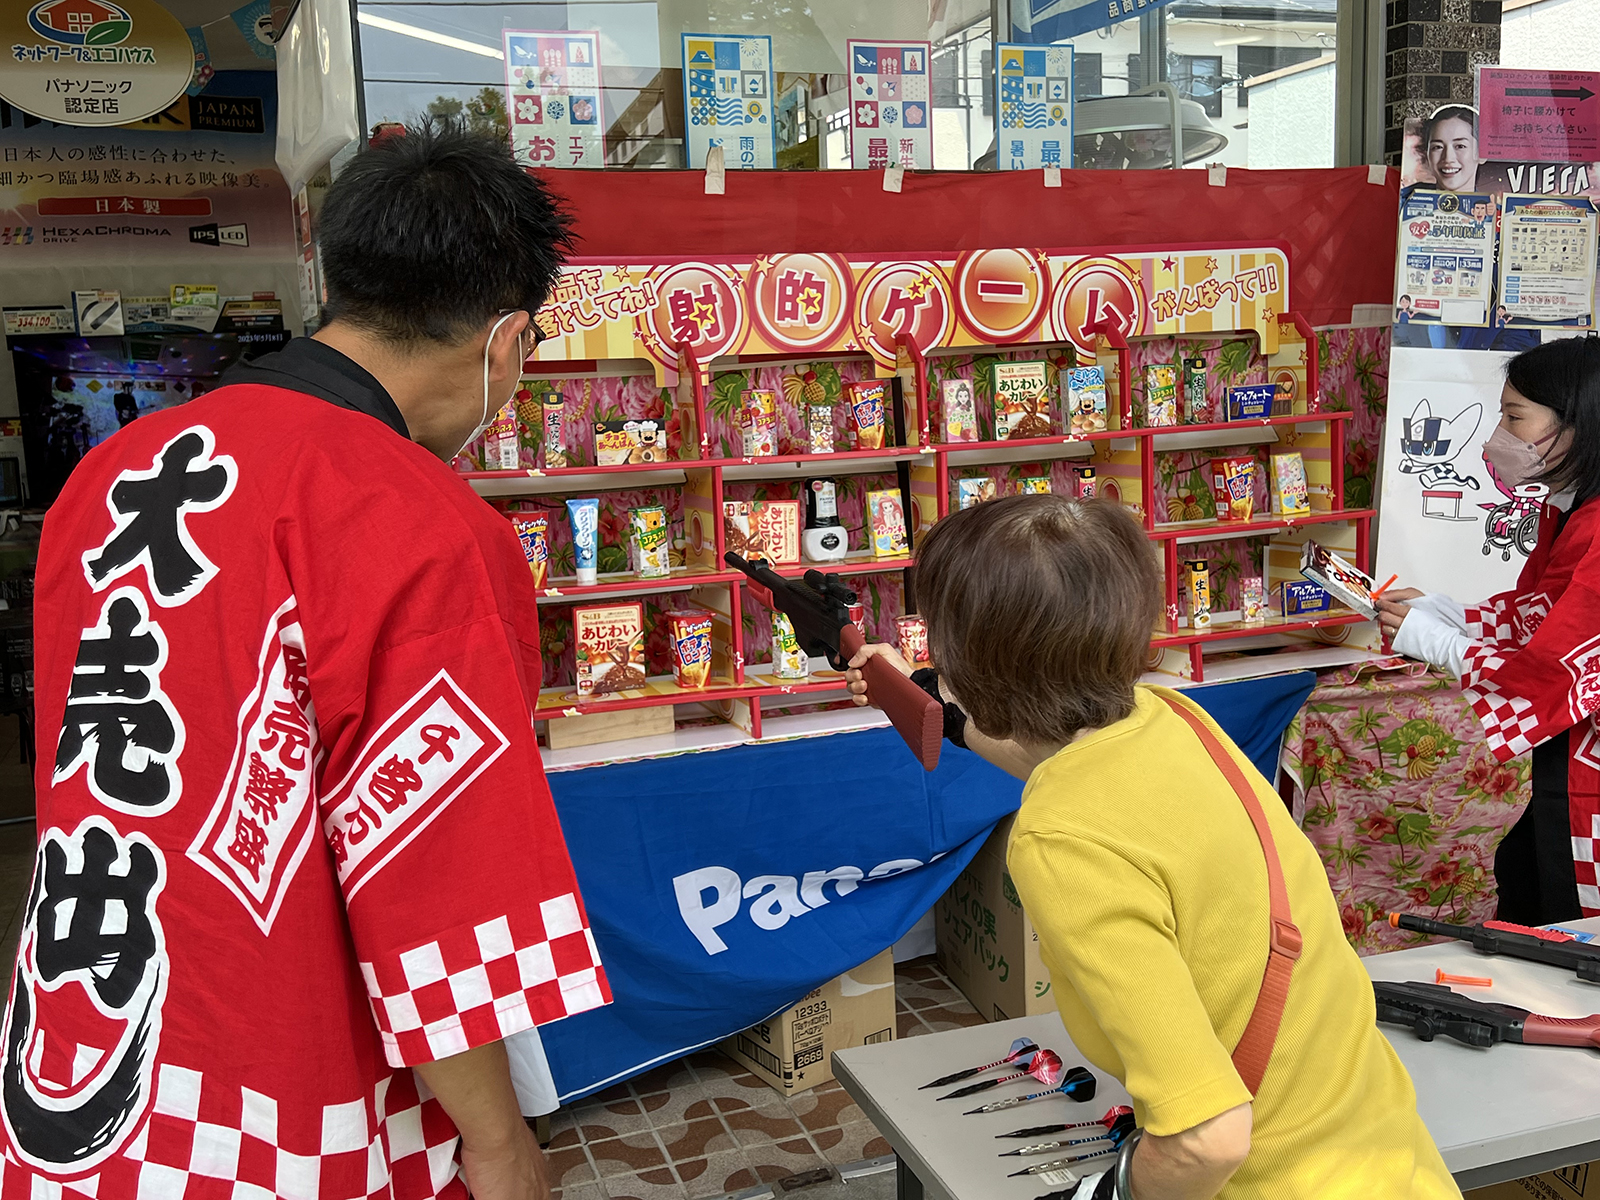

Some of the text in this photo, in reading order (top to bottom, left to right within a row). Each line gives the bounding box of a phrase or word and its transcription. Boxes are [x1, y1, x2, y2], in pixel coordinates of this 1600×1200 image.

[12, 46, 156, 64] ネットワーク&エコハウス
[45, 79, 132, 94] パナソニック
[64, 97, 119, 114] 認定店
[197, 101, 255, 116] JAPAN
[1502, 105, 1576, 117] 椅子に腰かけて
[199, 115, 256, 128] PREMIUM
[1513, 123, 1587, 134] お待ちください
[4, 146, 237, 165] 日本人の感性に合わせた、
[528, 135, 556, 168] お
[569, 136, 584, 166] エア
[739, 136, 755, 168] 雨の
[1041, 140, 1061, 169] 最
[1507, 165, 1589, 195] VIERA
[96, 199, 161, 214] 日本製
[193, 230, 244, 240] IPS LED
[543, 269, 602, 305] 品を
[1151, 265, 1278, 323] がんばって!!
[1073, 370, 1099, 380] ミルク
[999, 379, 1044, 392] あじわい
[1009, 391, 1037, 402] カレー
[1234, 389, 1271, 402] アルフォート
[605, 432, 627, 442] チョコ
[760, 518, 771, 552] カレー
[770, 502, 783, 560] あじわい
[581, 612, 601, 620] S&B
[581, 623, 637, 641] あじわい
[594, 641, 629, 653] カレー
[2, 430, 232, 1166] 大売出し
[795, 1000, 827, 1019] 12333
[796, 1049, 823, 1068] 2669
